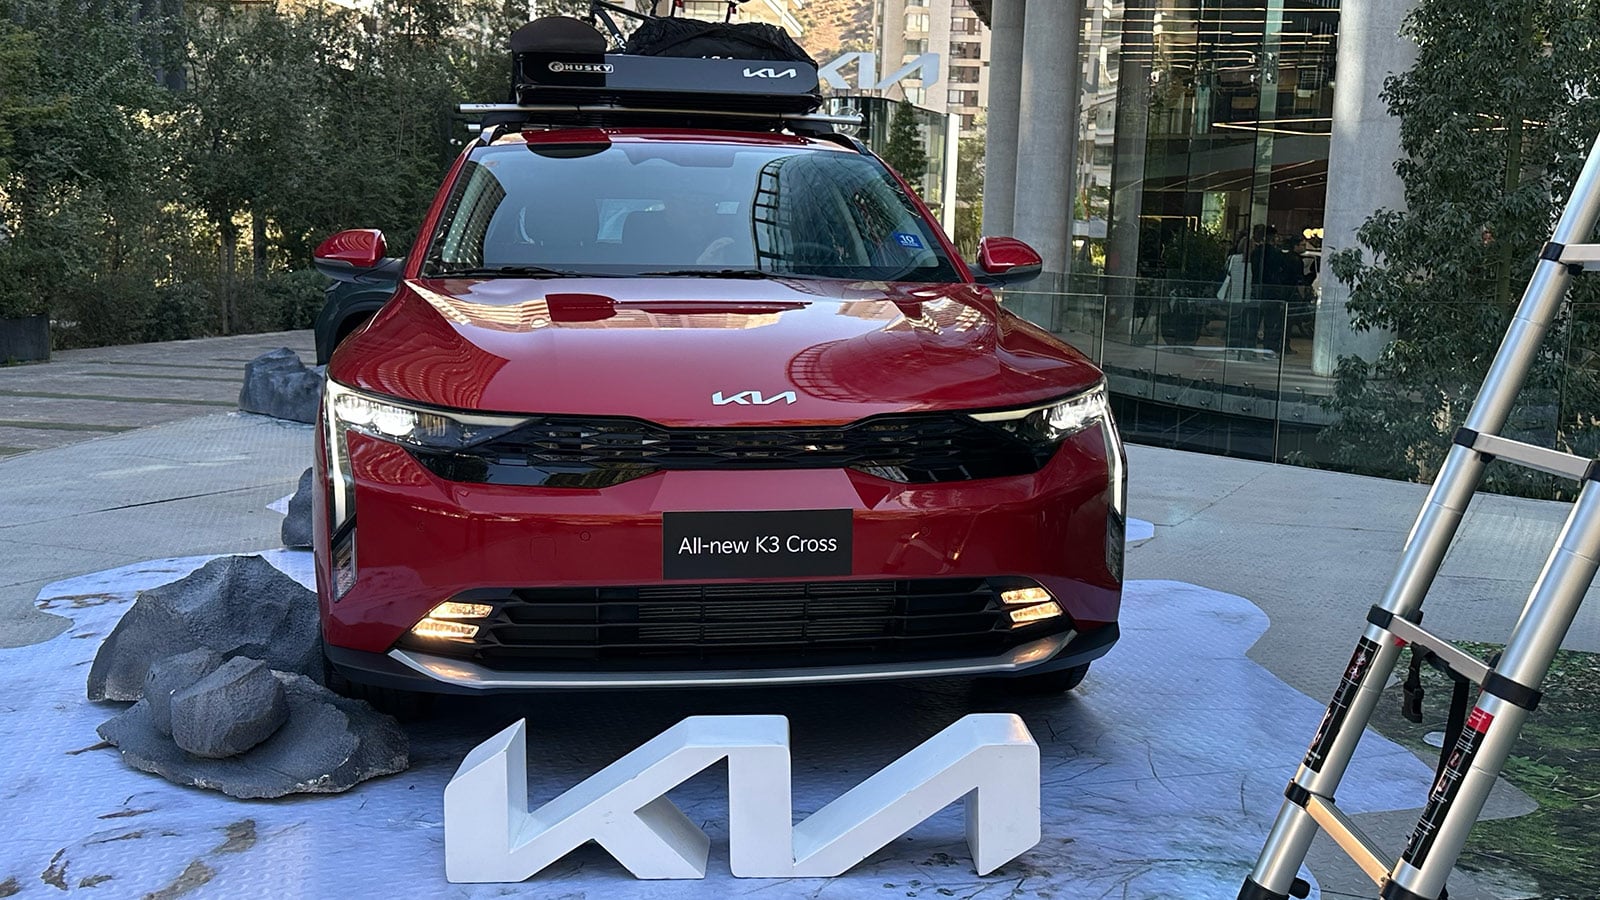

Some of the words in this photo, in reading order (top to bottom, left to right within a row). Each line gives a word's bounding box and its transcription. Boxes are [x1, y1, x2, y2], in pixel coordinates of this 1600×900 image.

[564, 64, 612, 72] HUSKY
[742, 67, 797, 78] KIA
[711, 390, 797, 405] KIA
[678, 537, 750, 555] All-new
[755, 535, 780, 554] K3
[786, 535, 837, 553] Cross
[443, 712, 1041, 883] KIA
